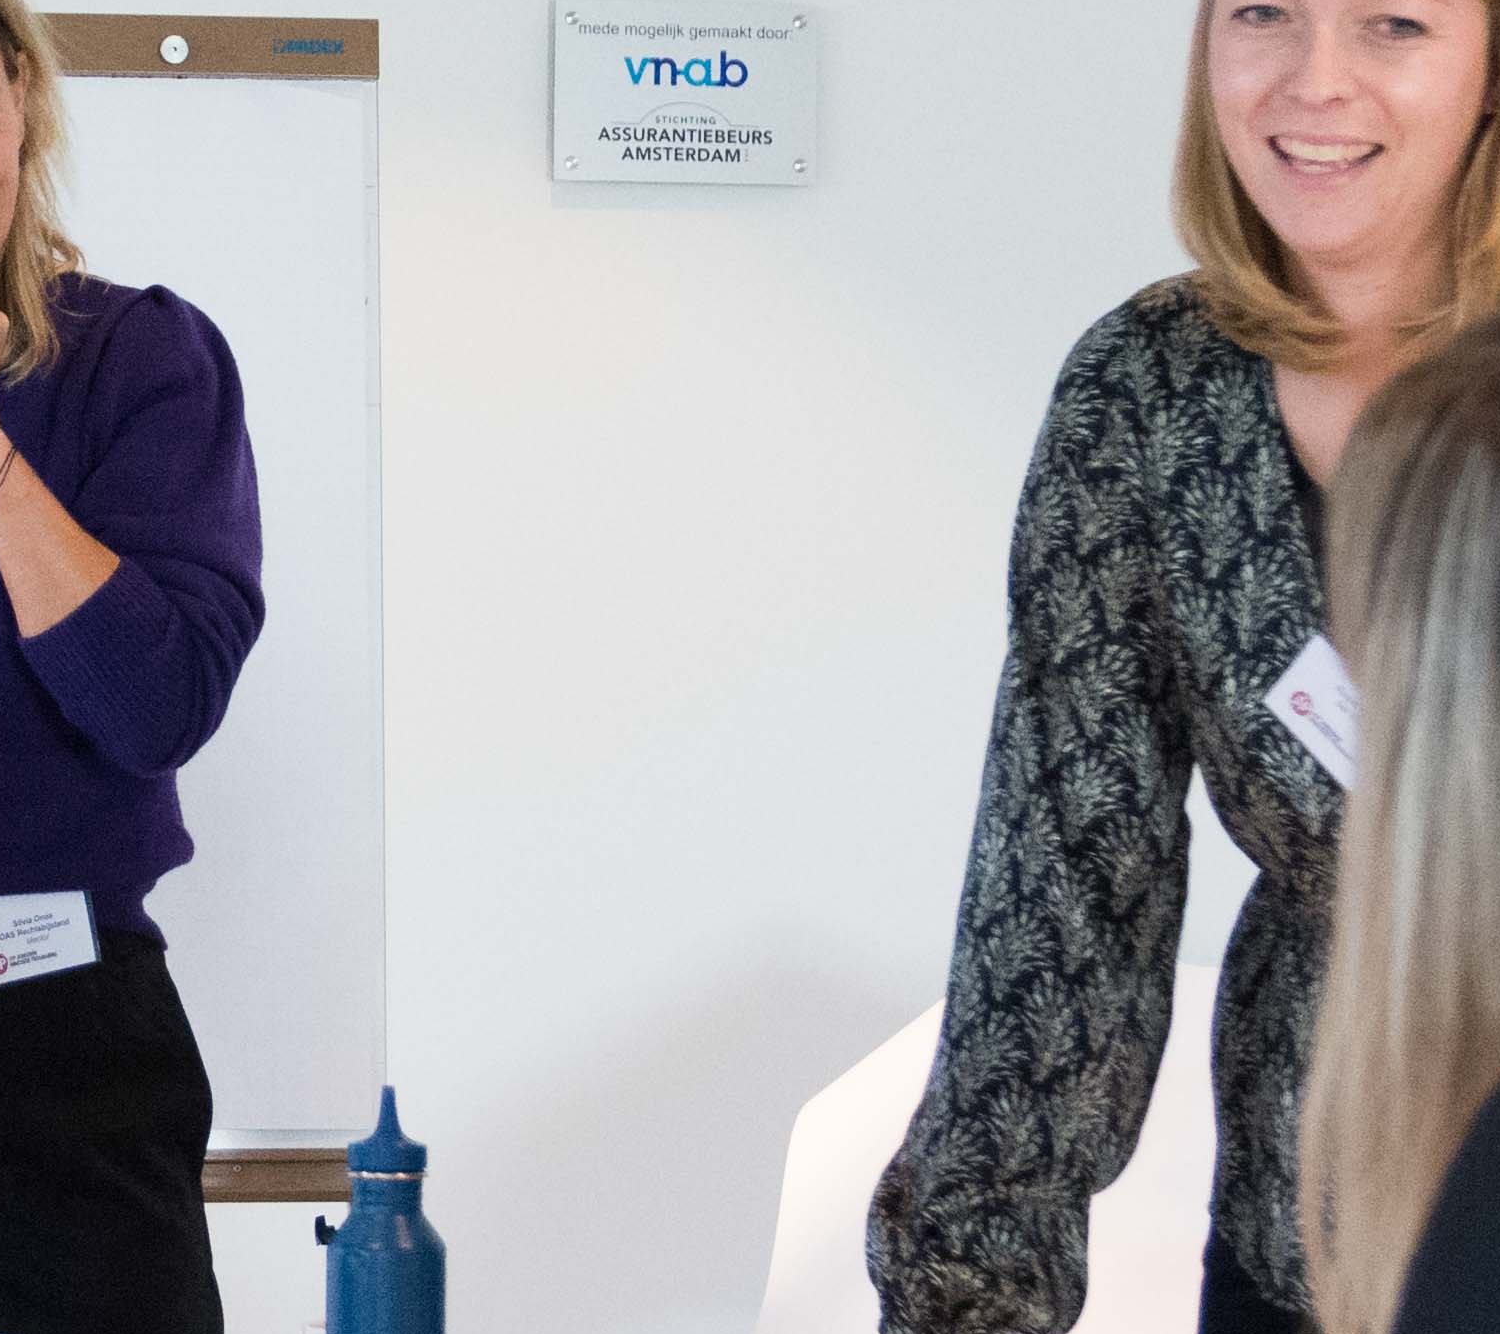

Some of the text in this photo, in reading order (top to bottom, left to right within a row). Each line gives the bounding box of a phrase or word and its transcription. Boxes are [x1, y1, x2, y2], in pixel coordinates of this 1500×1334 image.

[578, 22, 620, 35] mede
[624, 24, 685, 40] mogelijk
[689, 26, 752, 41] gemaakt
[655, 114, 717, 125] STICHTING
[598, 126, 773, 145] ASSURANTIEBEURS
[621, 146, 741, 163] AMSTERDAM
